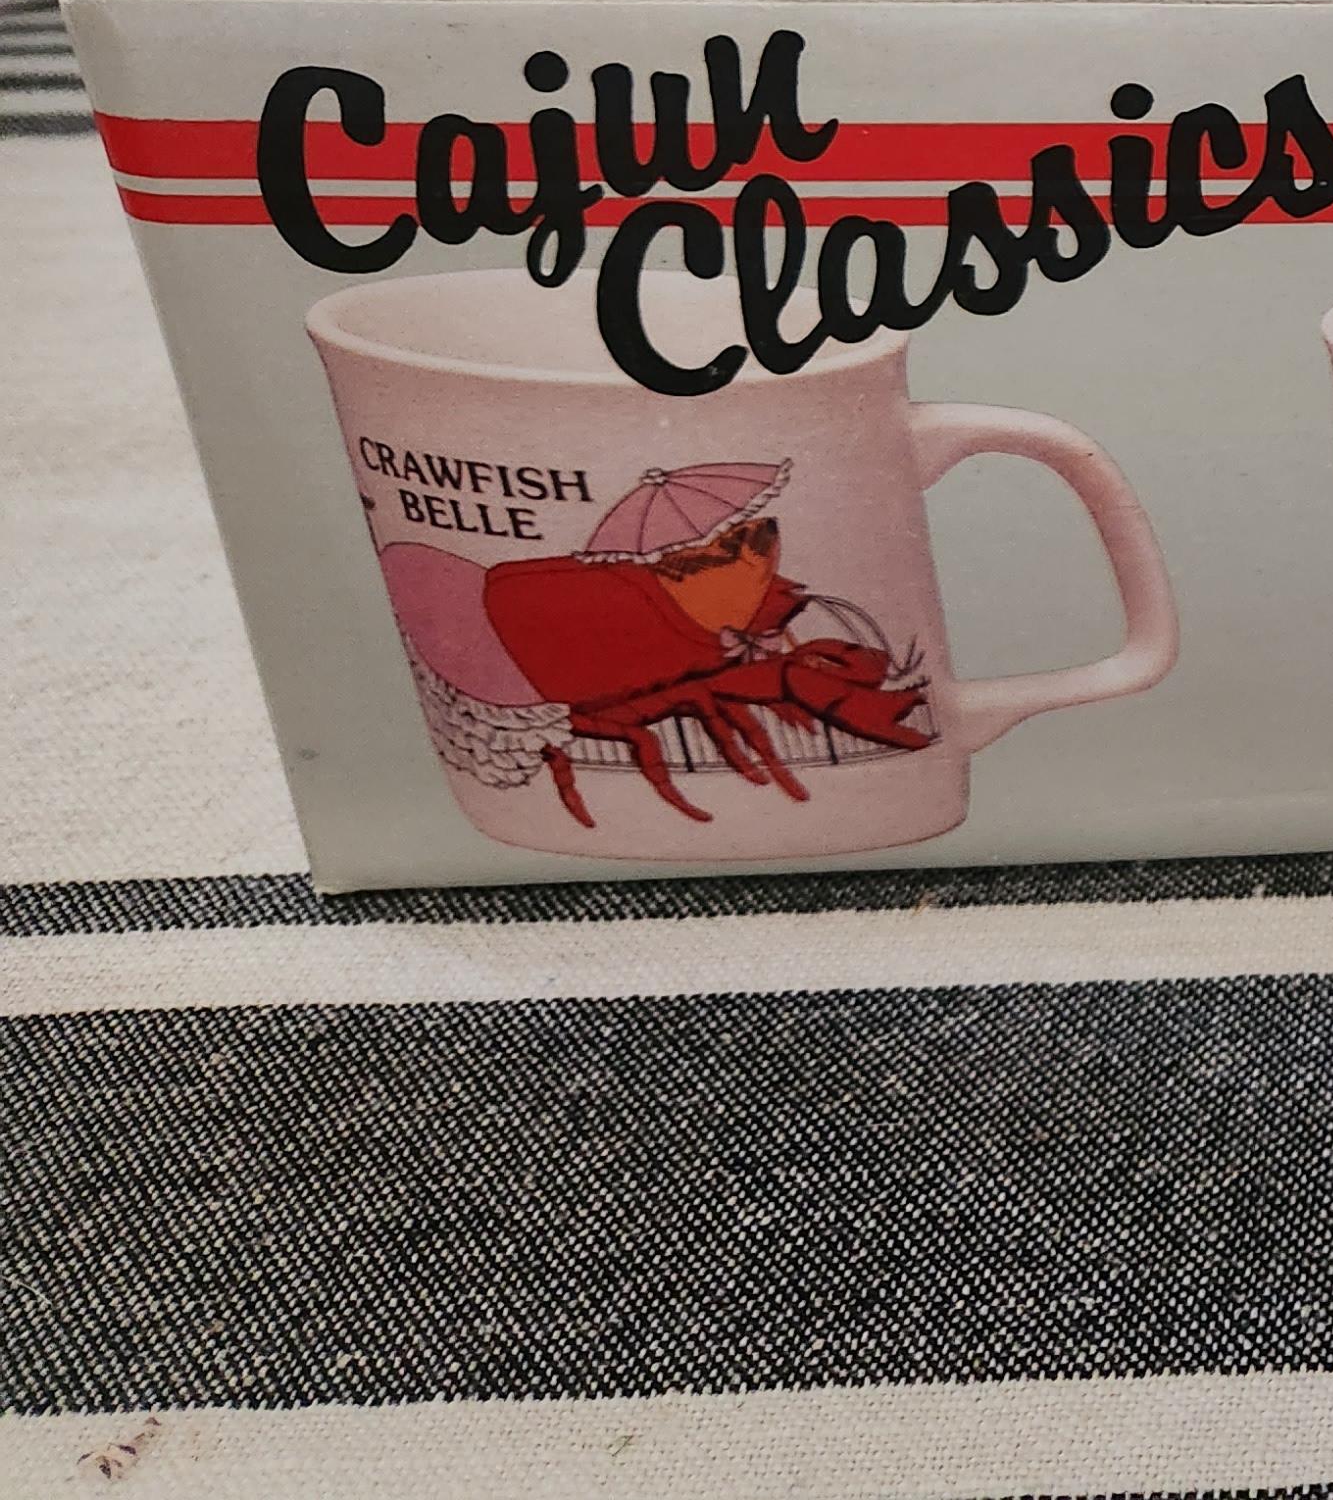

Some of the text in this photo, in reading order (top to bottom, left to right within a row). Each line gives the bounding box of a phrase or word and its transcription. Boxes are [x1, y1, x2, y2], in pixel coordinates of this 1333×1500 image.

[256, 29, 839, 288] Cajun
[360, 436, 594, 502] CRAWFISH
[398, 488, 544, 541] BELLE
